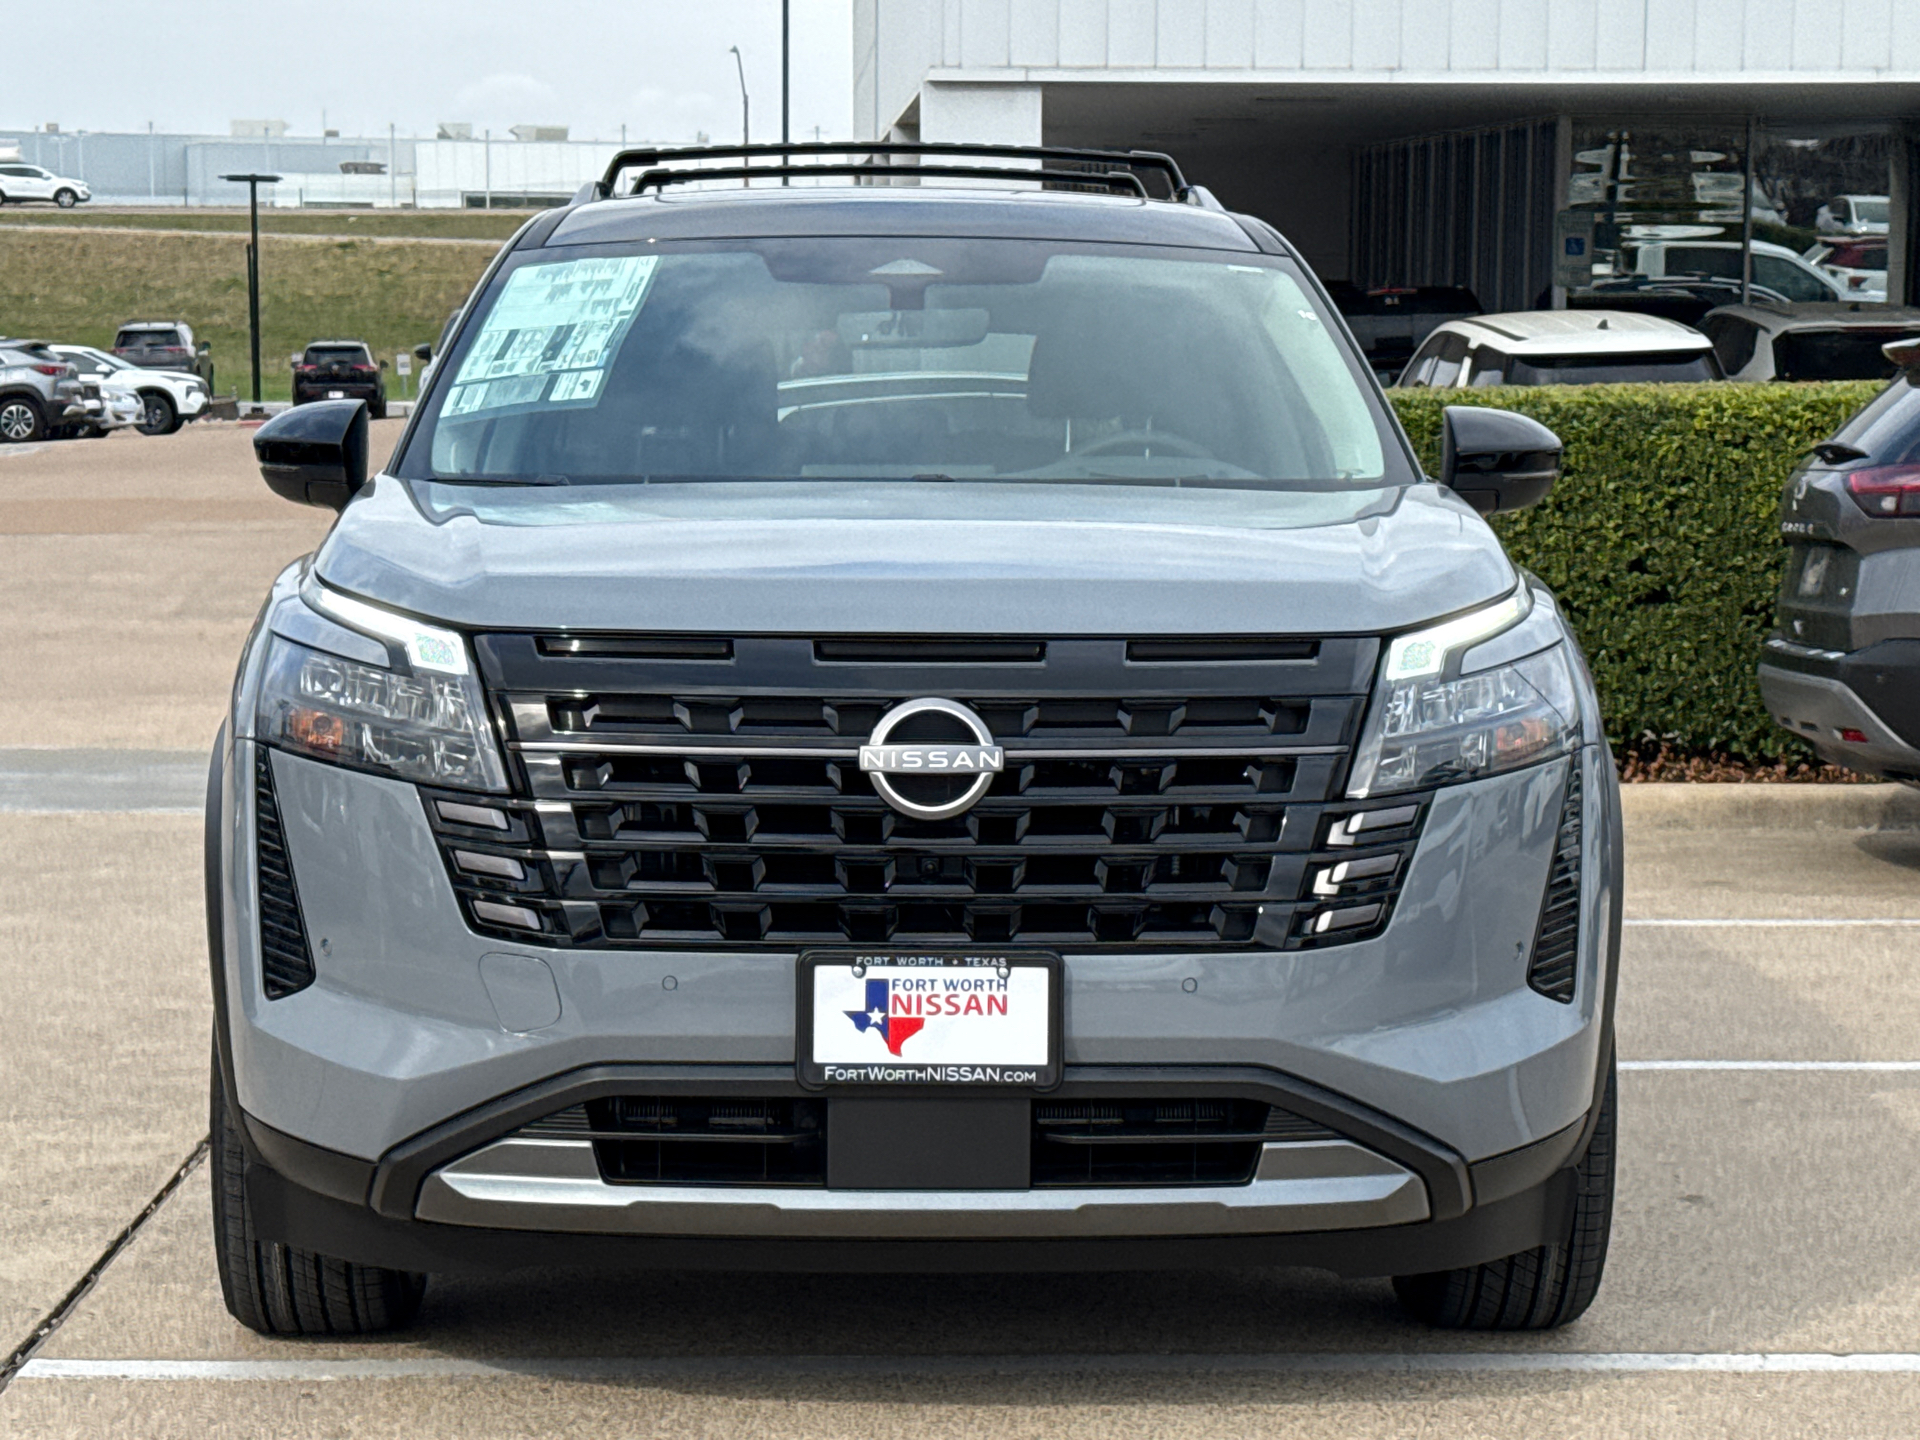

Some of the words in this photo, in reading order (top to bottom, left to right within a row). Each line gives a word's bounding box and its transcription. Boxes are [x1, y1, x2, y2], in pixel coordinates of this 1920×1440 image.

[863, 751, 1000, 768] NISSAN
[856, 956, 890, 965] FORT
[896, 956, 944, 966] WORTH
[964, 957, 1007, 967] TEXAS
[891, 978, 938, 992] FORT
[943, 979, 1008, 992] WORTH
[891, 994, 1007, 1015] NISSAN
